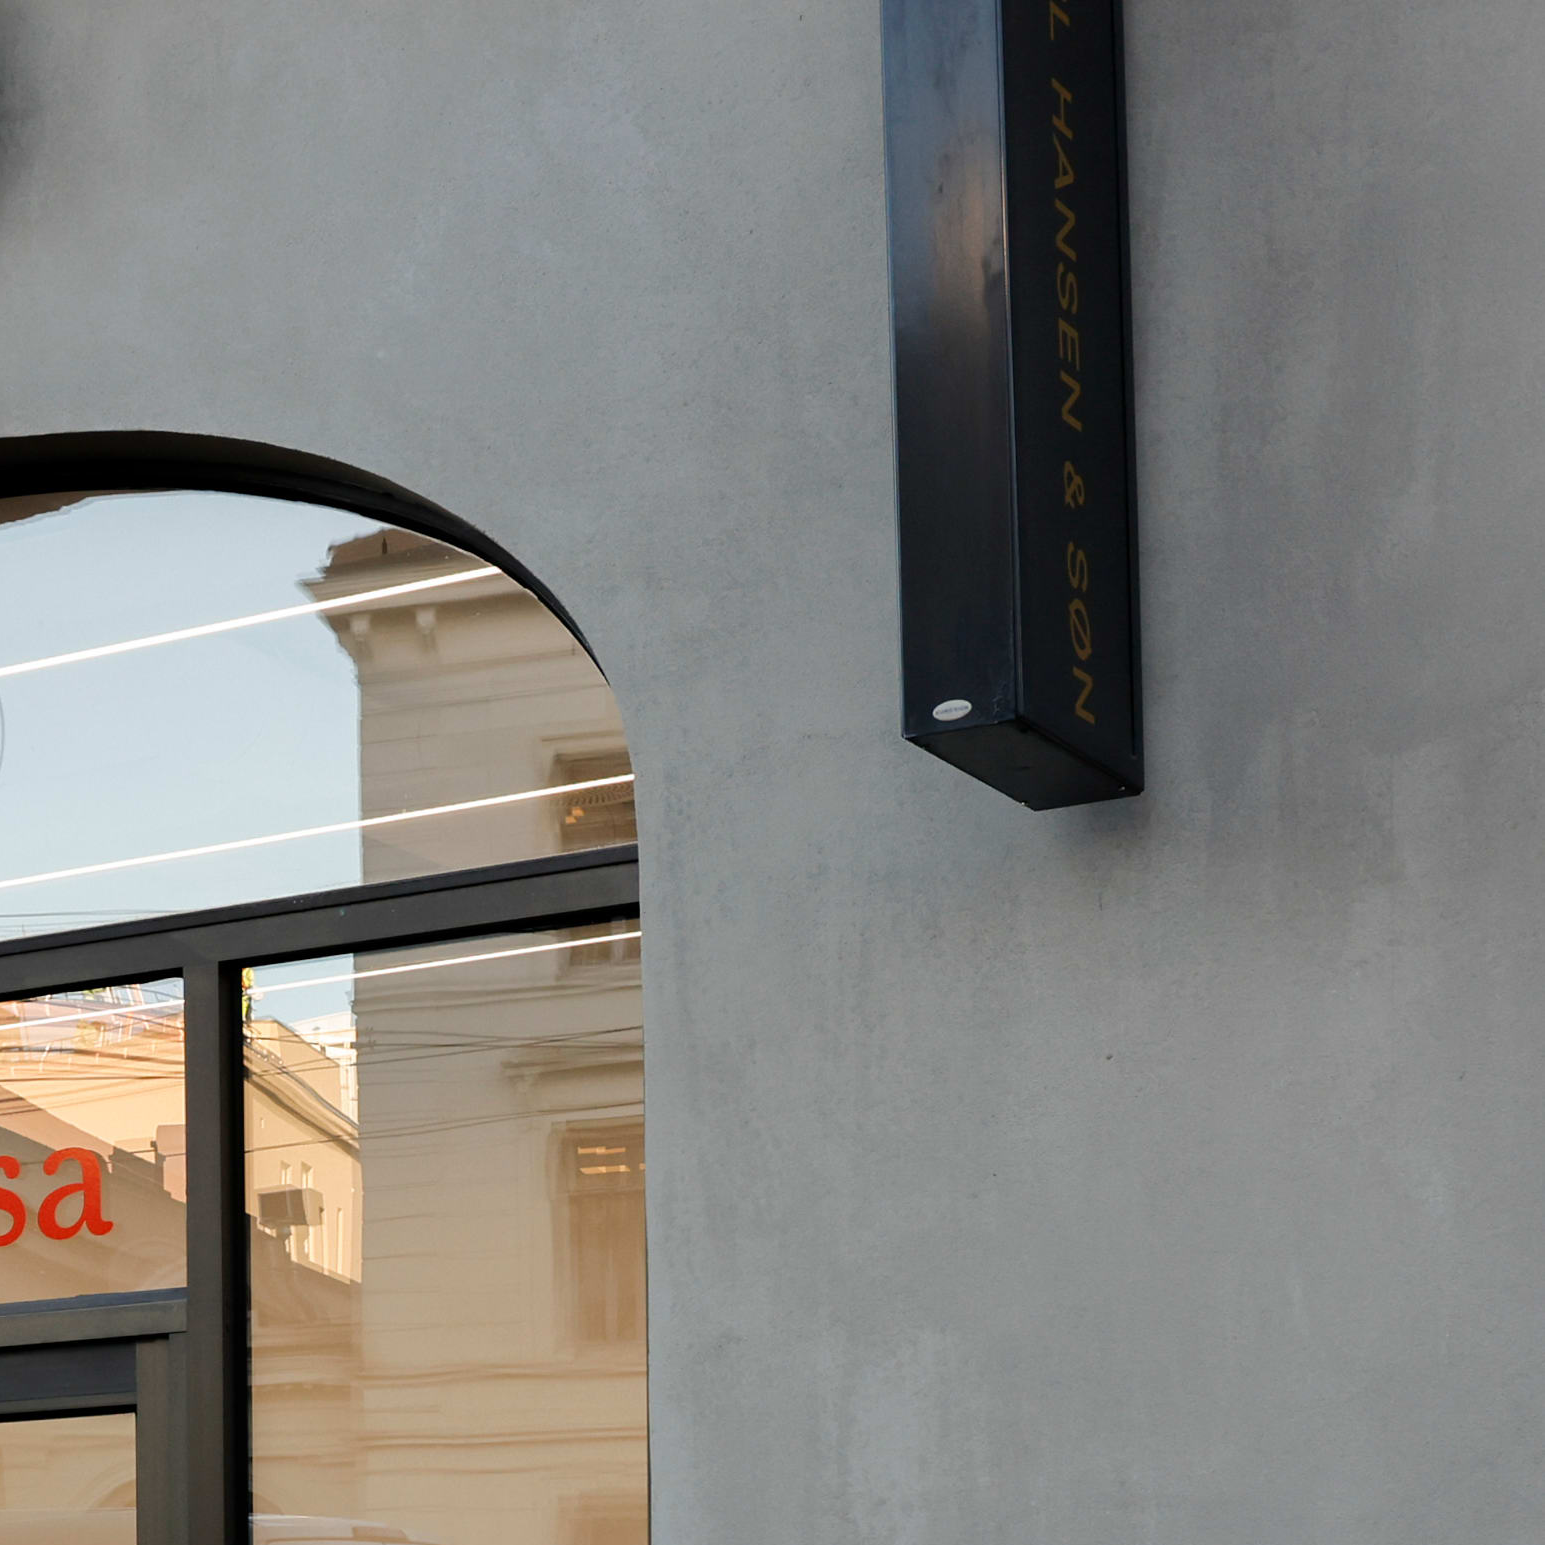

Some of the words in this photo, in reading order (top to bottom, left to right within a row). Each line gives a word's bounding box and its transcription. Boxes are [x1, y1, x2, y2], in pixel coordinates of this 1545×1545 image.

[1051, 78, 1082, 432] HANSEN
[1064, 461, 1085, 508] &
[1067, 542, 1095, 724] SØN
